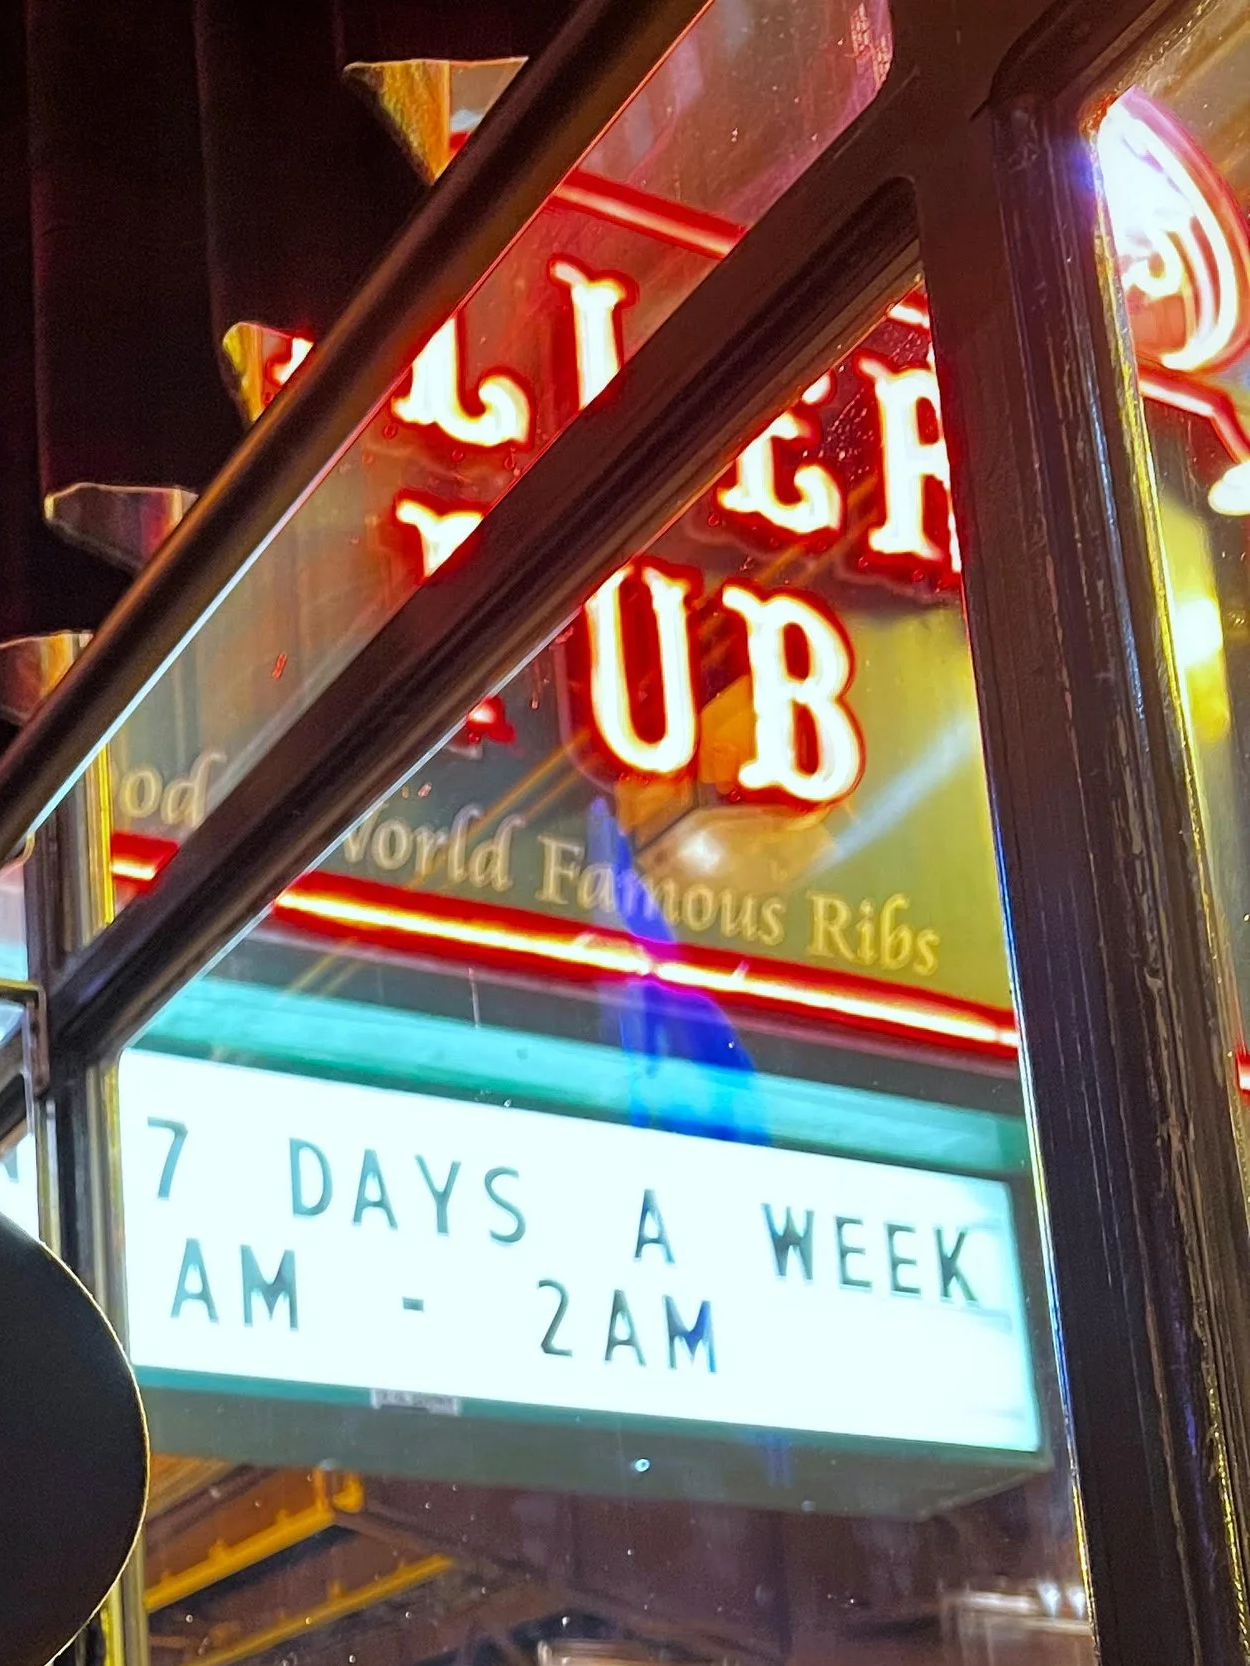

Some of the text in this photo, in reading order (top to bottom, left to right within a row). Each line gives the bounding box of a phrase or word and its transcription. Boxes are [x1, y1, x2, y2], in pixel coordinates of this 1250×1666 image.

[113, 752, 227, 829] od
[536, 833, 787, 947] Famous
[806, 890, 941, 977] Ribs
[147, 1116, 189, 1201] 7
[289, 1137, 528, 1245] DAYS
[634, 1188, 676, 1265] A
[762, 1203, 979, 1302] WEEK
[538, 1280, 717, 1373] 2AM
